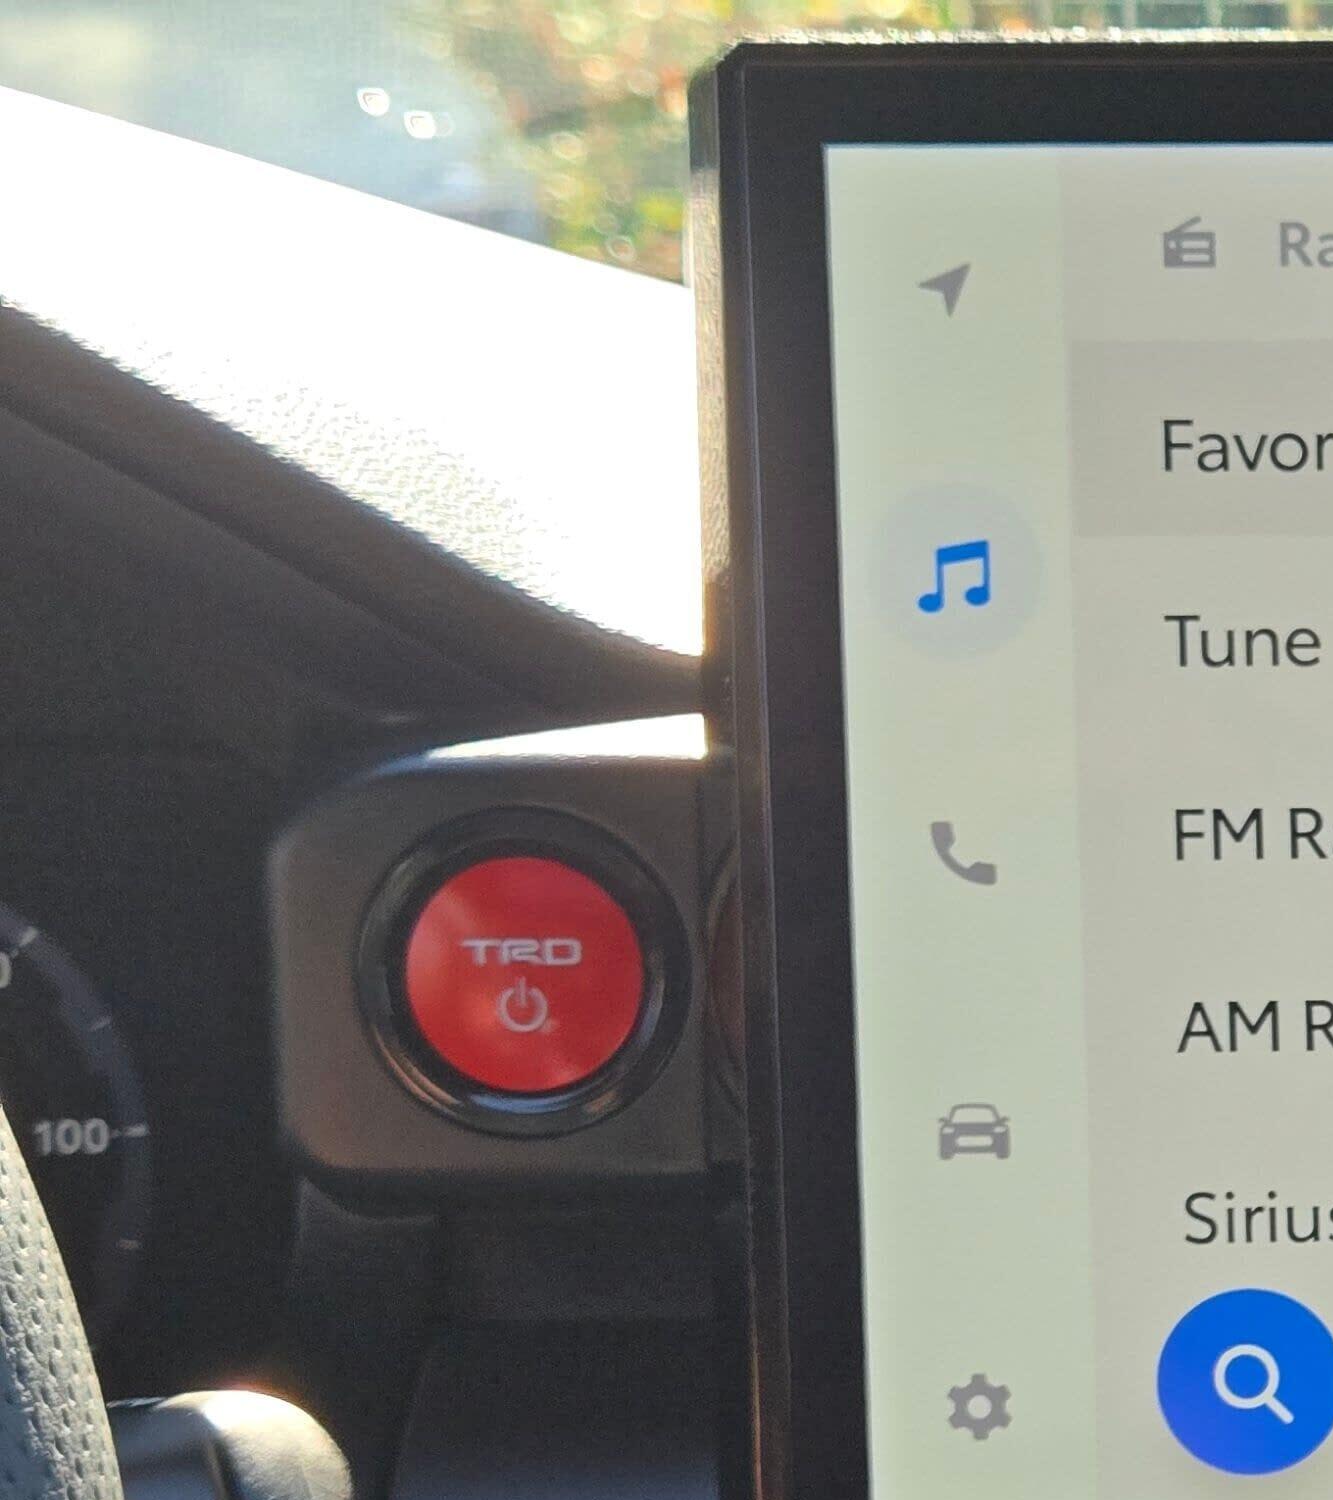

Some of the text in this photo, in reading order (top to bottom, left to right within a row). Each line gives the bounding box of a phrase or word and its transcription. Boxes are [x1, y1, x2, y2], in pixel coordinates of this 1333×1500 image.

[1164, 615, 1320, 667] Tune
[1176, 808, 1263, 860] FM
[460, 938, 583, 966] TRD
[1178, 1001, 1279, 1052] AM
[33, 1117, 109, 1155] 100
